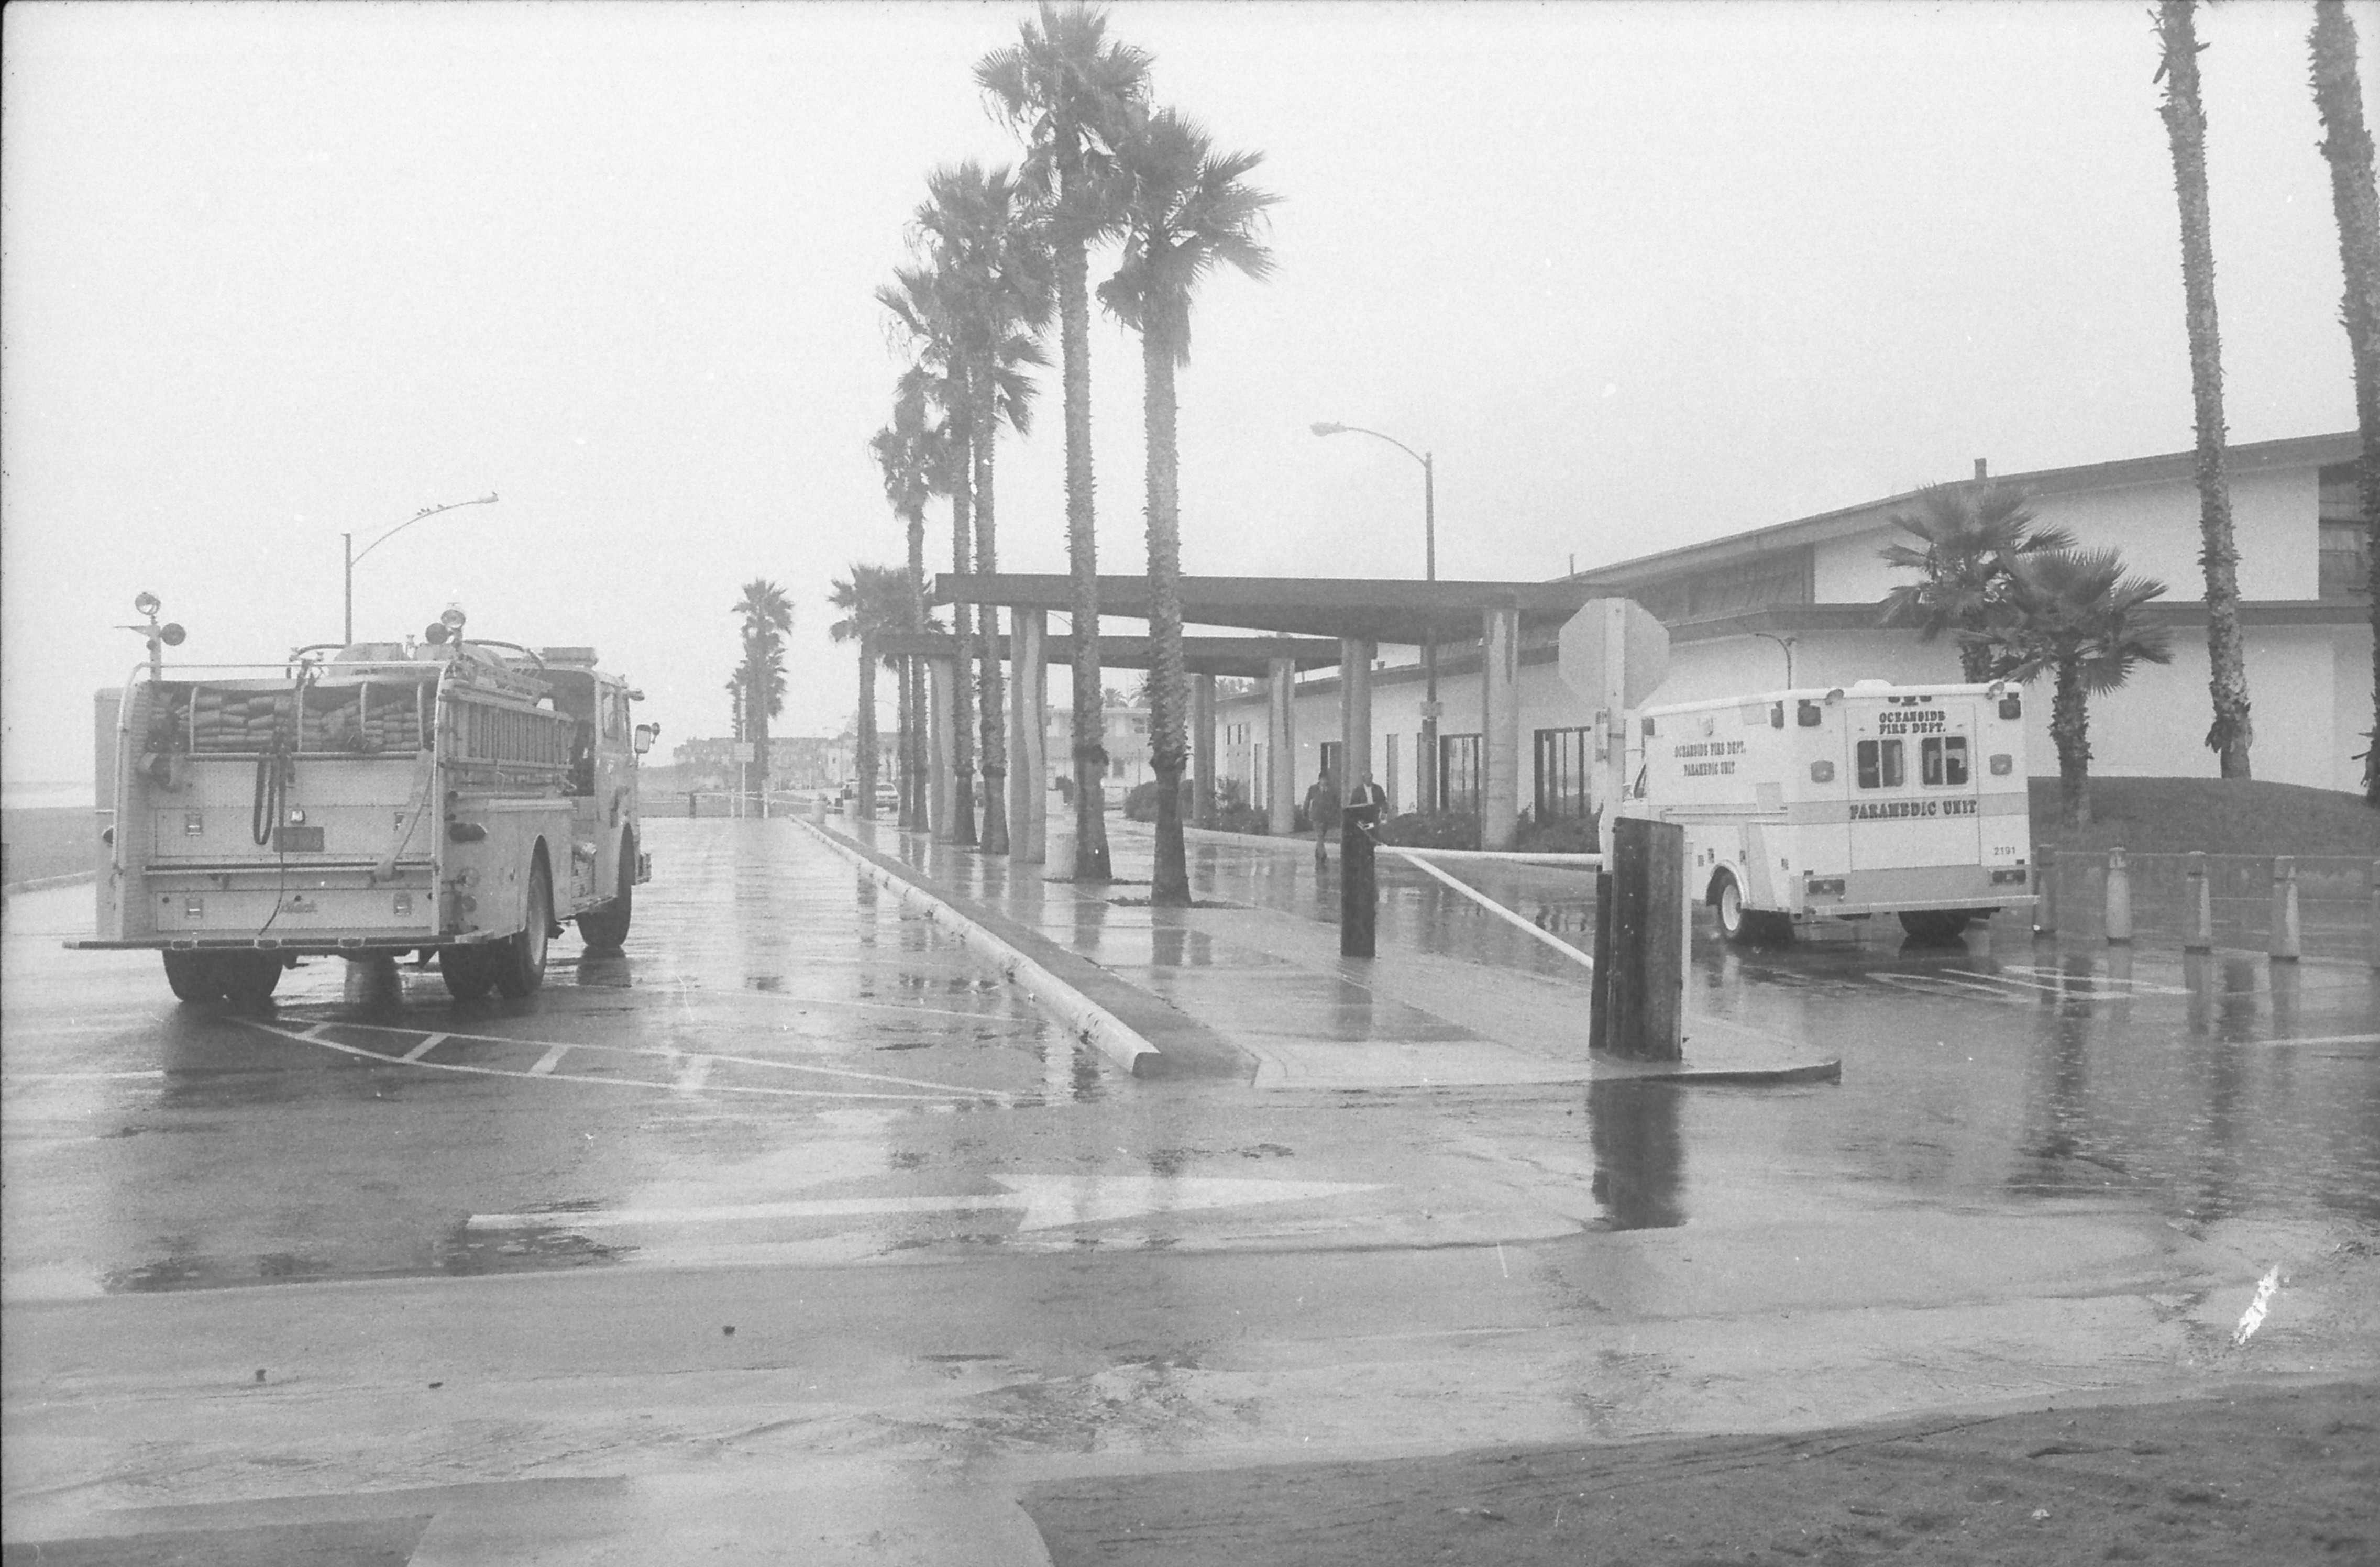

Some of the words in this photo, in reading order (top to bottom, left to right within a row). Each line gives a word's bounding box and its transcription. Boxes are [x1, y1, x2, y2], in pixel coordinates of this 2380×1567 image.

[1879, 710, 1945, 723] OCEANSIDE
[1879, 723, 1907, 734] FIRE
[1912, 722, 1946, 733] DEPT.
[1674, 743, 1707, 758] OCEANSIDE
[1710, 742, 1724, 756] FIRE
[1683, 762, 1718, 776] PARAMEDIC
[1721, 760, 1735, 775] UNIT
[1849, 801, 1937, 820] PARAMEDIC
[1942, 799, 1977, 815] UNIT
[1993, 846, 2015, 856] 2191
